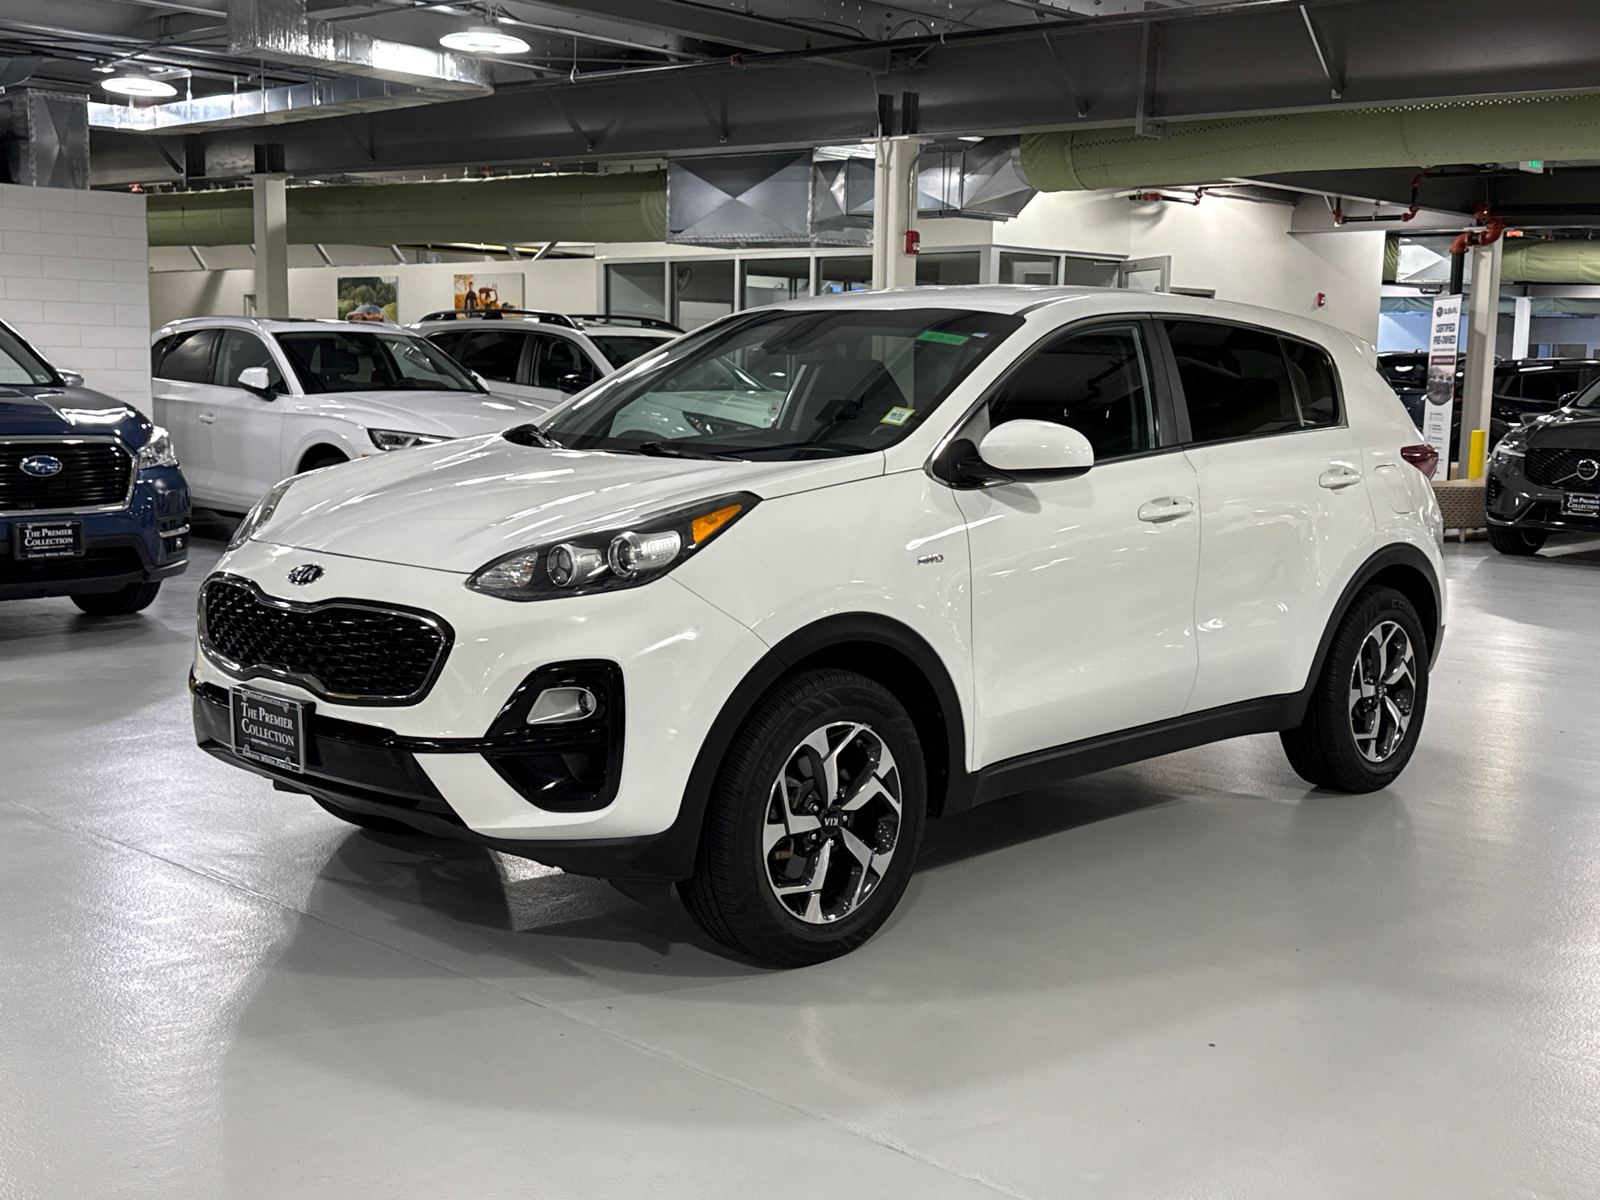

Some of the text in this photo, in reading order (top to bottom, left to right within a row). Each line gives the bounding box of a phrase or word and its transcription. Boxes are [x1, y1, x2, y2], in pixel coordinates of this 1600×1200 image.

[1567, 502, 1600, 510] COLLECTION
[42, 529, 73, 537] PREMIER
[24, 538, 73, 546] COLLECTION
[241, 702, 293, 730] THE PREMIER
[241, 718, 295, 747] COLLECTION
[824, 817, 839, 827] KIA
